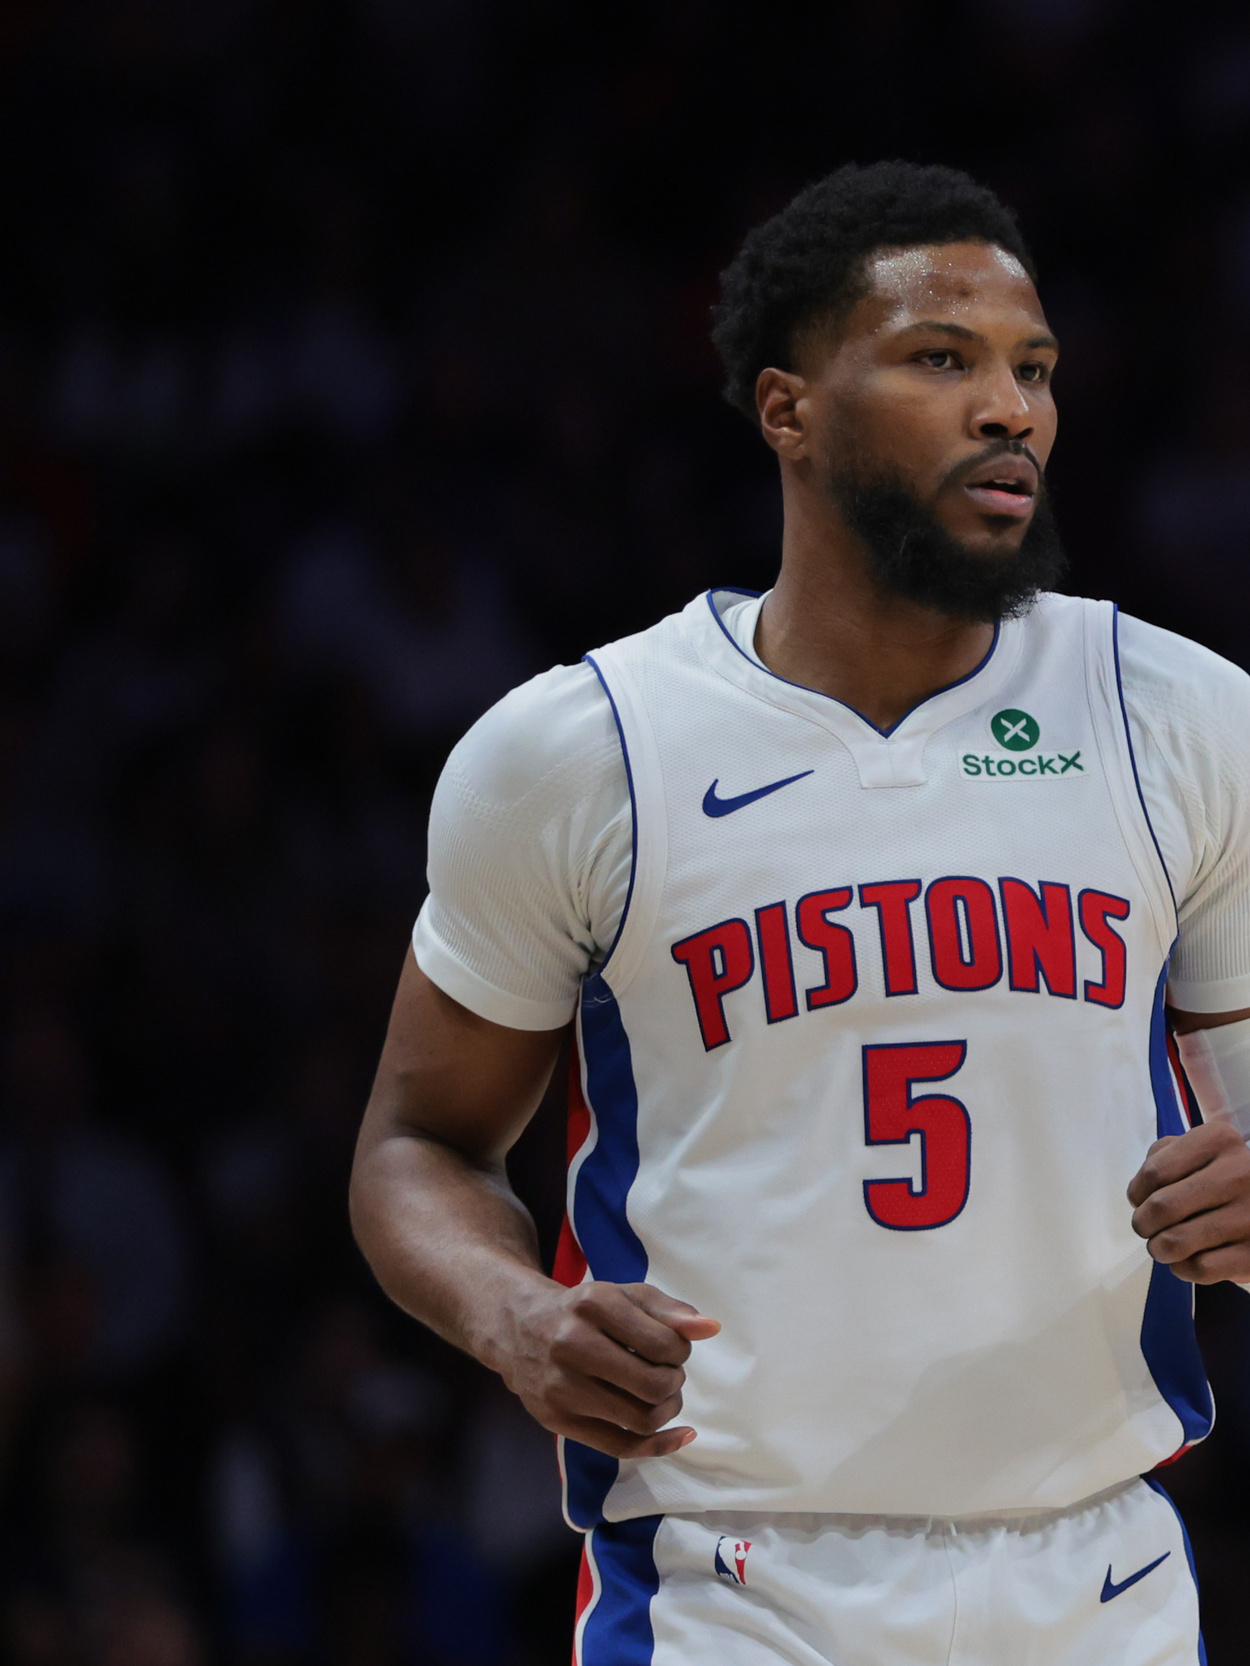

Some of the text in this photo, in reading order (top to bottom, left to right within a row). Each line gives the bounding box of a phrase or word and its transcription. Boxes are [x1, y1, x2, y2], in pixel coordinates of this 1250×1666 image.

[962, 750, 1084, 776] StockX
[671, 876, 1130, 1052] PISTONS
[862, 1039, 971, 1231] 5
